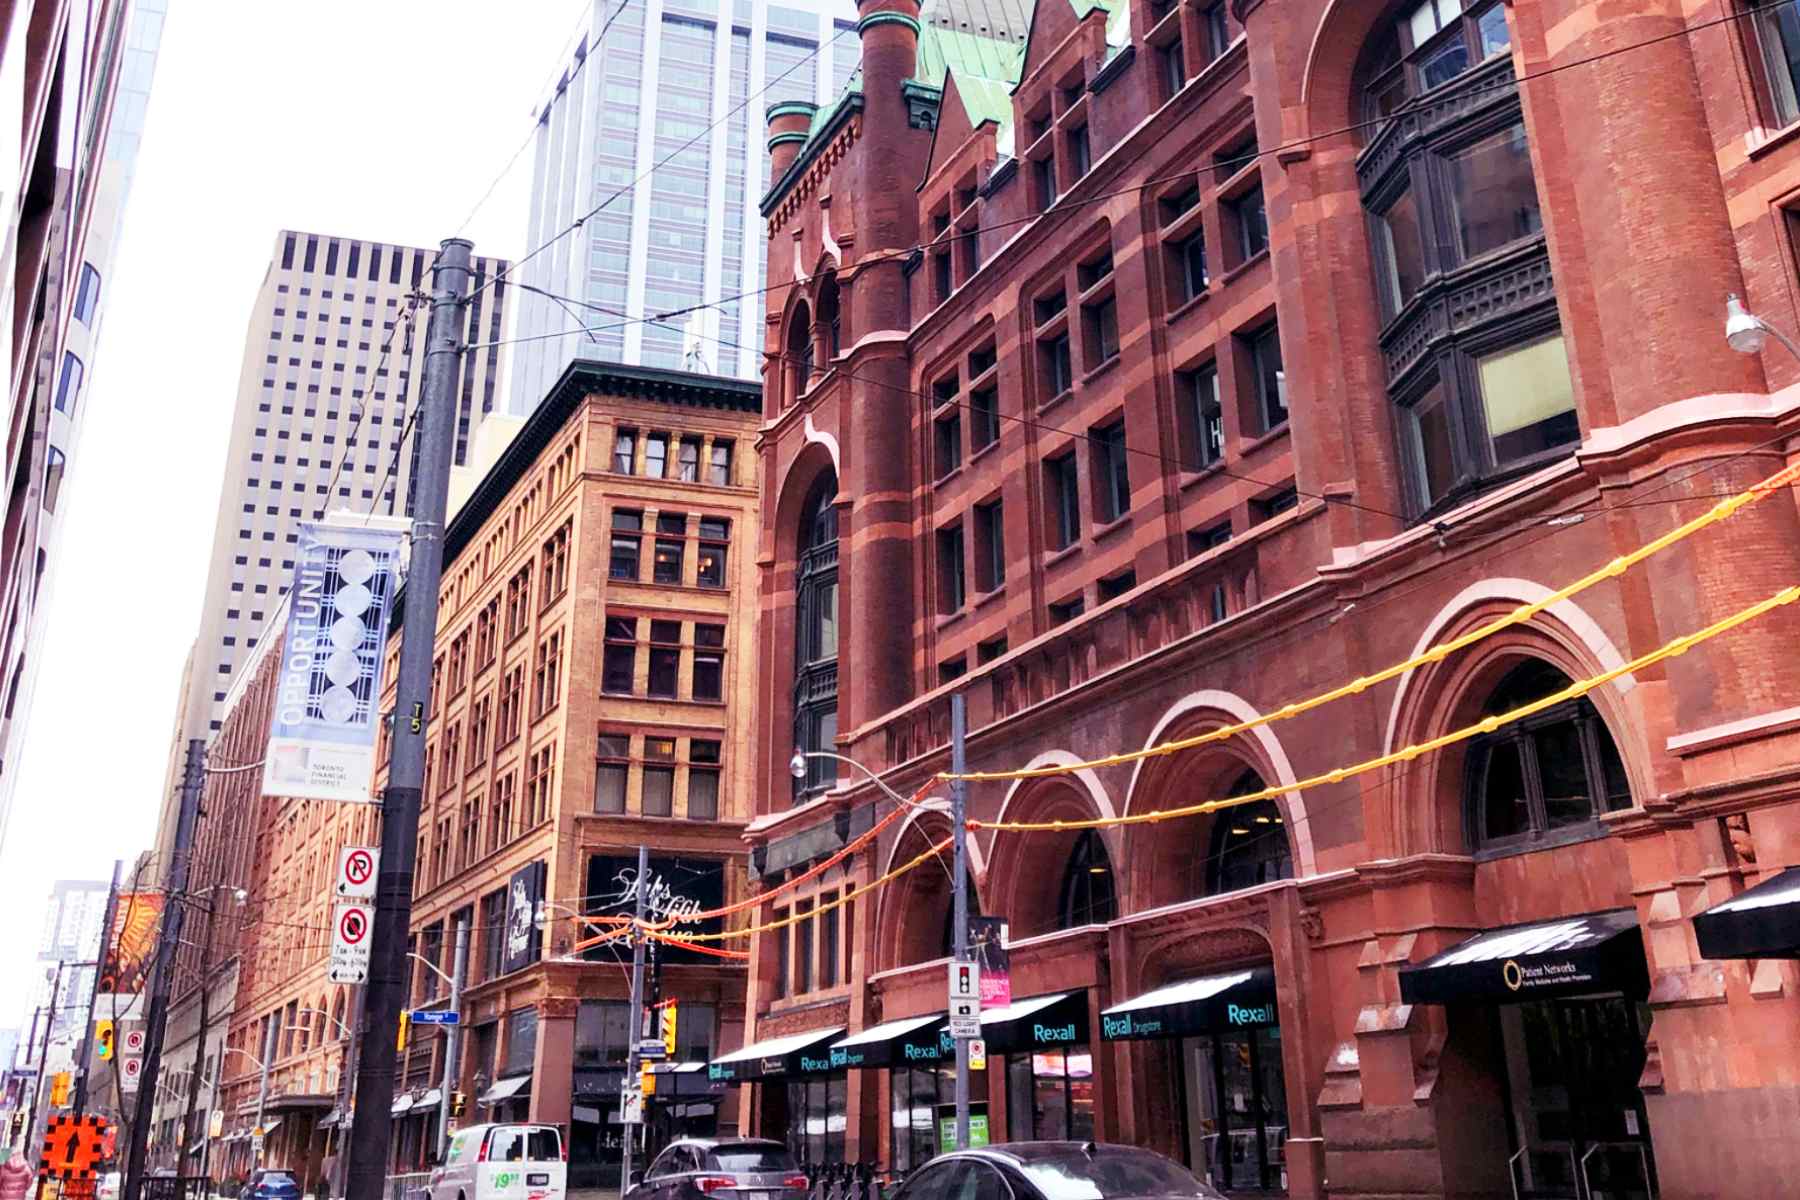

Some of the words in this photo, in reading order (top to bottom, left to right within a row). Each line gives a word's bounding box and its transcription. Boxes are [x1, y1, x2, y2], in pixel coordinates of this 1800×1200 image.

[279, 534, 324, 727] OPPORTUNITY
[1521, 966, 1543, 978] Patient
[1543, 961, 1577, 975] Networks
[1228, 1004, 1274, 1026] Rexall
[1033, 1023, 1076, 1043] Rexall
[1103, 1014, 1132, 1040] Rexall
